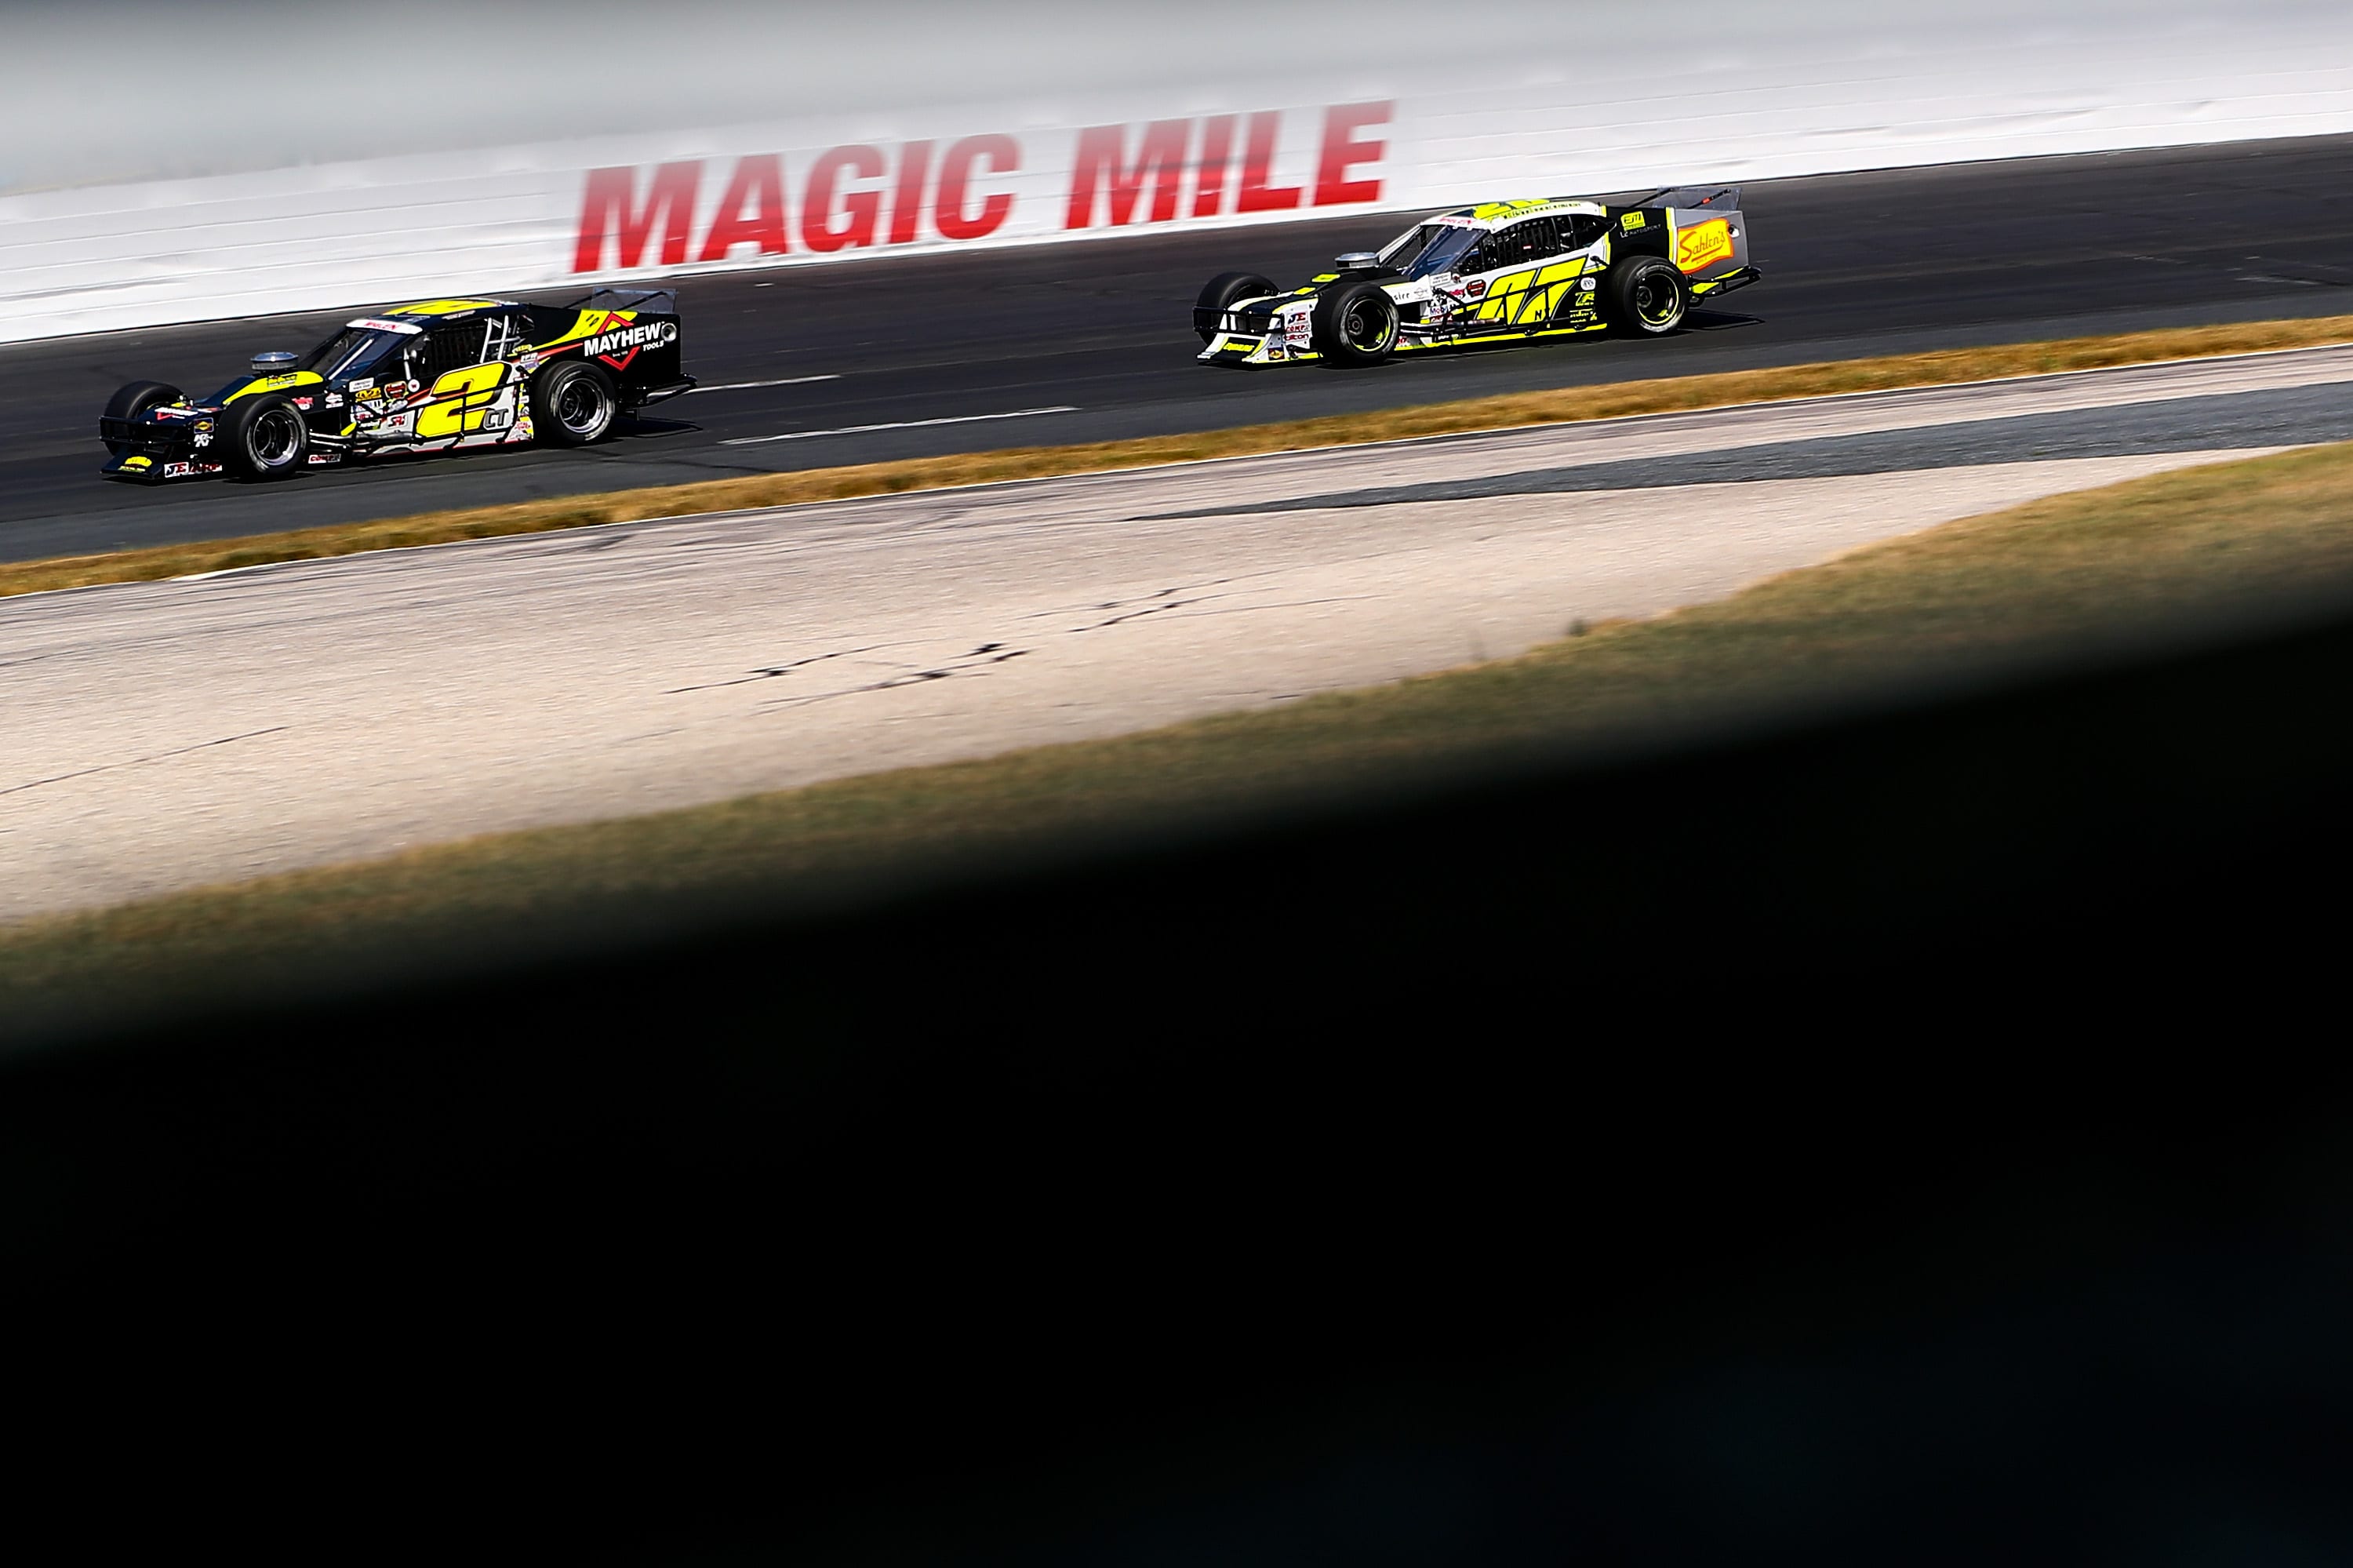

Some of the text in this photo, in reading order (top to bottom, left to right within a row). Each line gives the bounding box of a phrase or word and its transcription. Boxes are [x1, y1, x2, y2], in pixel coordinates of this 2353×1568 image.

[571, 100, 1393, 274] MAGIC MILE
[1679, 231, 1726, 264] Sahlen's
[584, 322, 662, 357] MAYHEW
[643, 340, 664, 351] TOOLS
[417, 361, 511, 438] 2
[485, 408, 509, 429] CT
